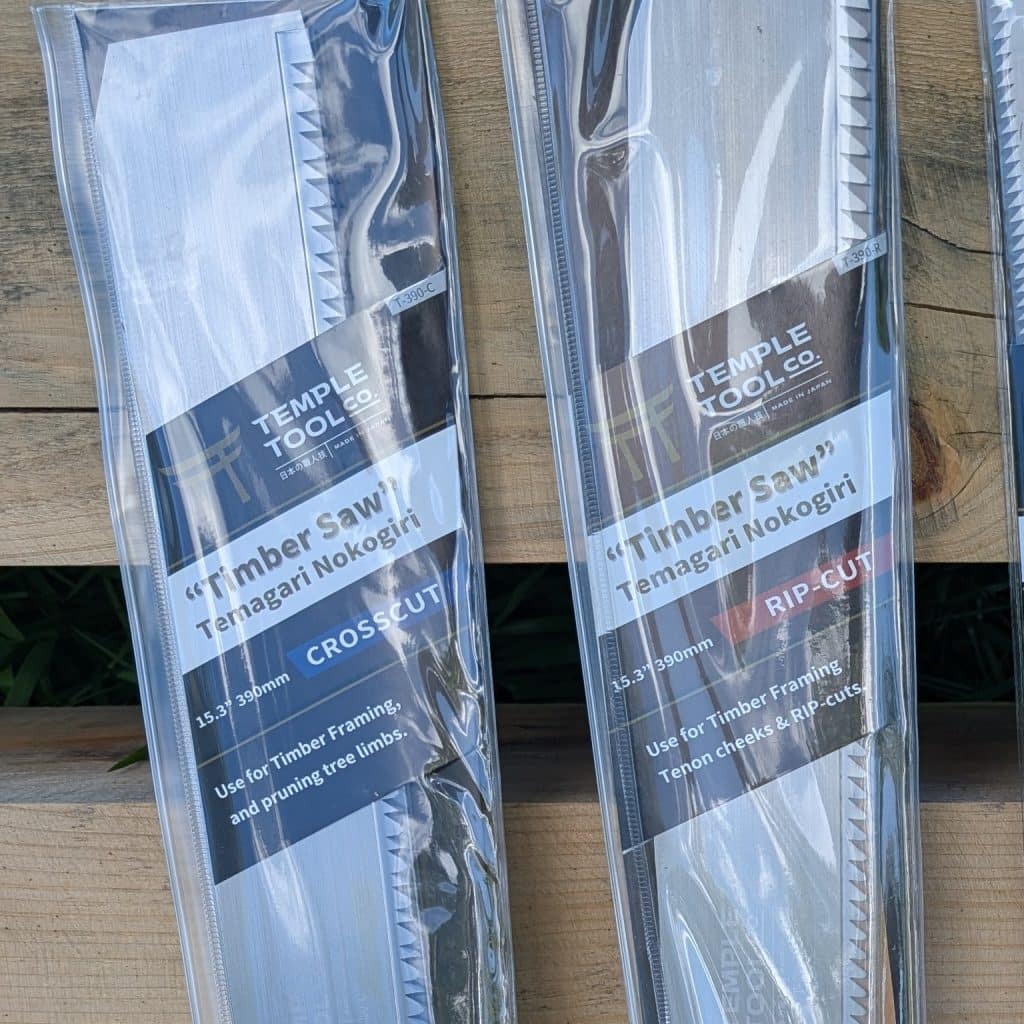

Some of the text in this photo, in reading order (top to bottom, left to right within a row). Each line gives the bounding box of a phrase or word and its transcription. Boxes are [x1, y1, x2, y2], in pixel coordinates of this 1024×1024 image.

[687, 322, 812, 394] TEMPLE
[700, 349, 822, 417] TOOL CO.
[772, 379, 833, 410] MADE IN JAPAN
[251, 362, 369, 435] TEMPLE
[264, 408, 346, 458] TOOL
[343, 388, 379, 412] CO.
[606, 438, 835, 562] “Timber Saw”
[185, 475, 400, 602] “Timber Saw”
[616, 473, 857, 602] Temagari Nokogiri
[196, 508, 423, 641] Temagari Nokogiri
[765, 551, 874, 617] RIP-CUT
[306, 582, 442, 667] CROSSCUT
[655, 637, 714, 673] 390mm
[196, 670, 291, 729] 15.3” 390mm
[647, 658, 842, 757] Use for Timber Framing
[215, 697, 402, 801] Use for Timber Framing,
[230, 727, 408, 826] and pruning tree limbs.
[658, 753, 713, 785] Tenon
[716, 725, 773, 759] cheeks
[776, 716, 791, 731] &
